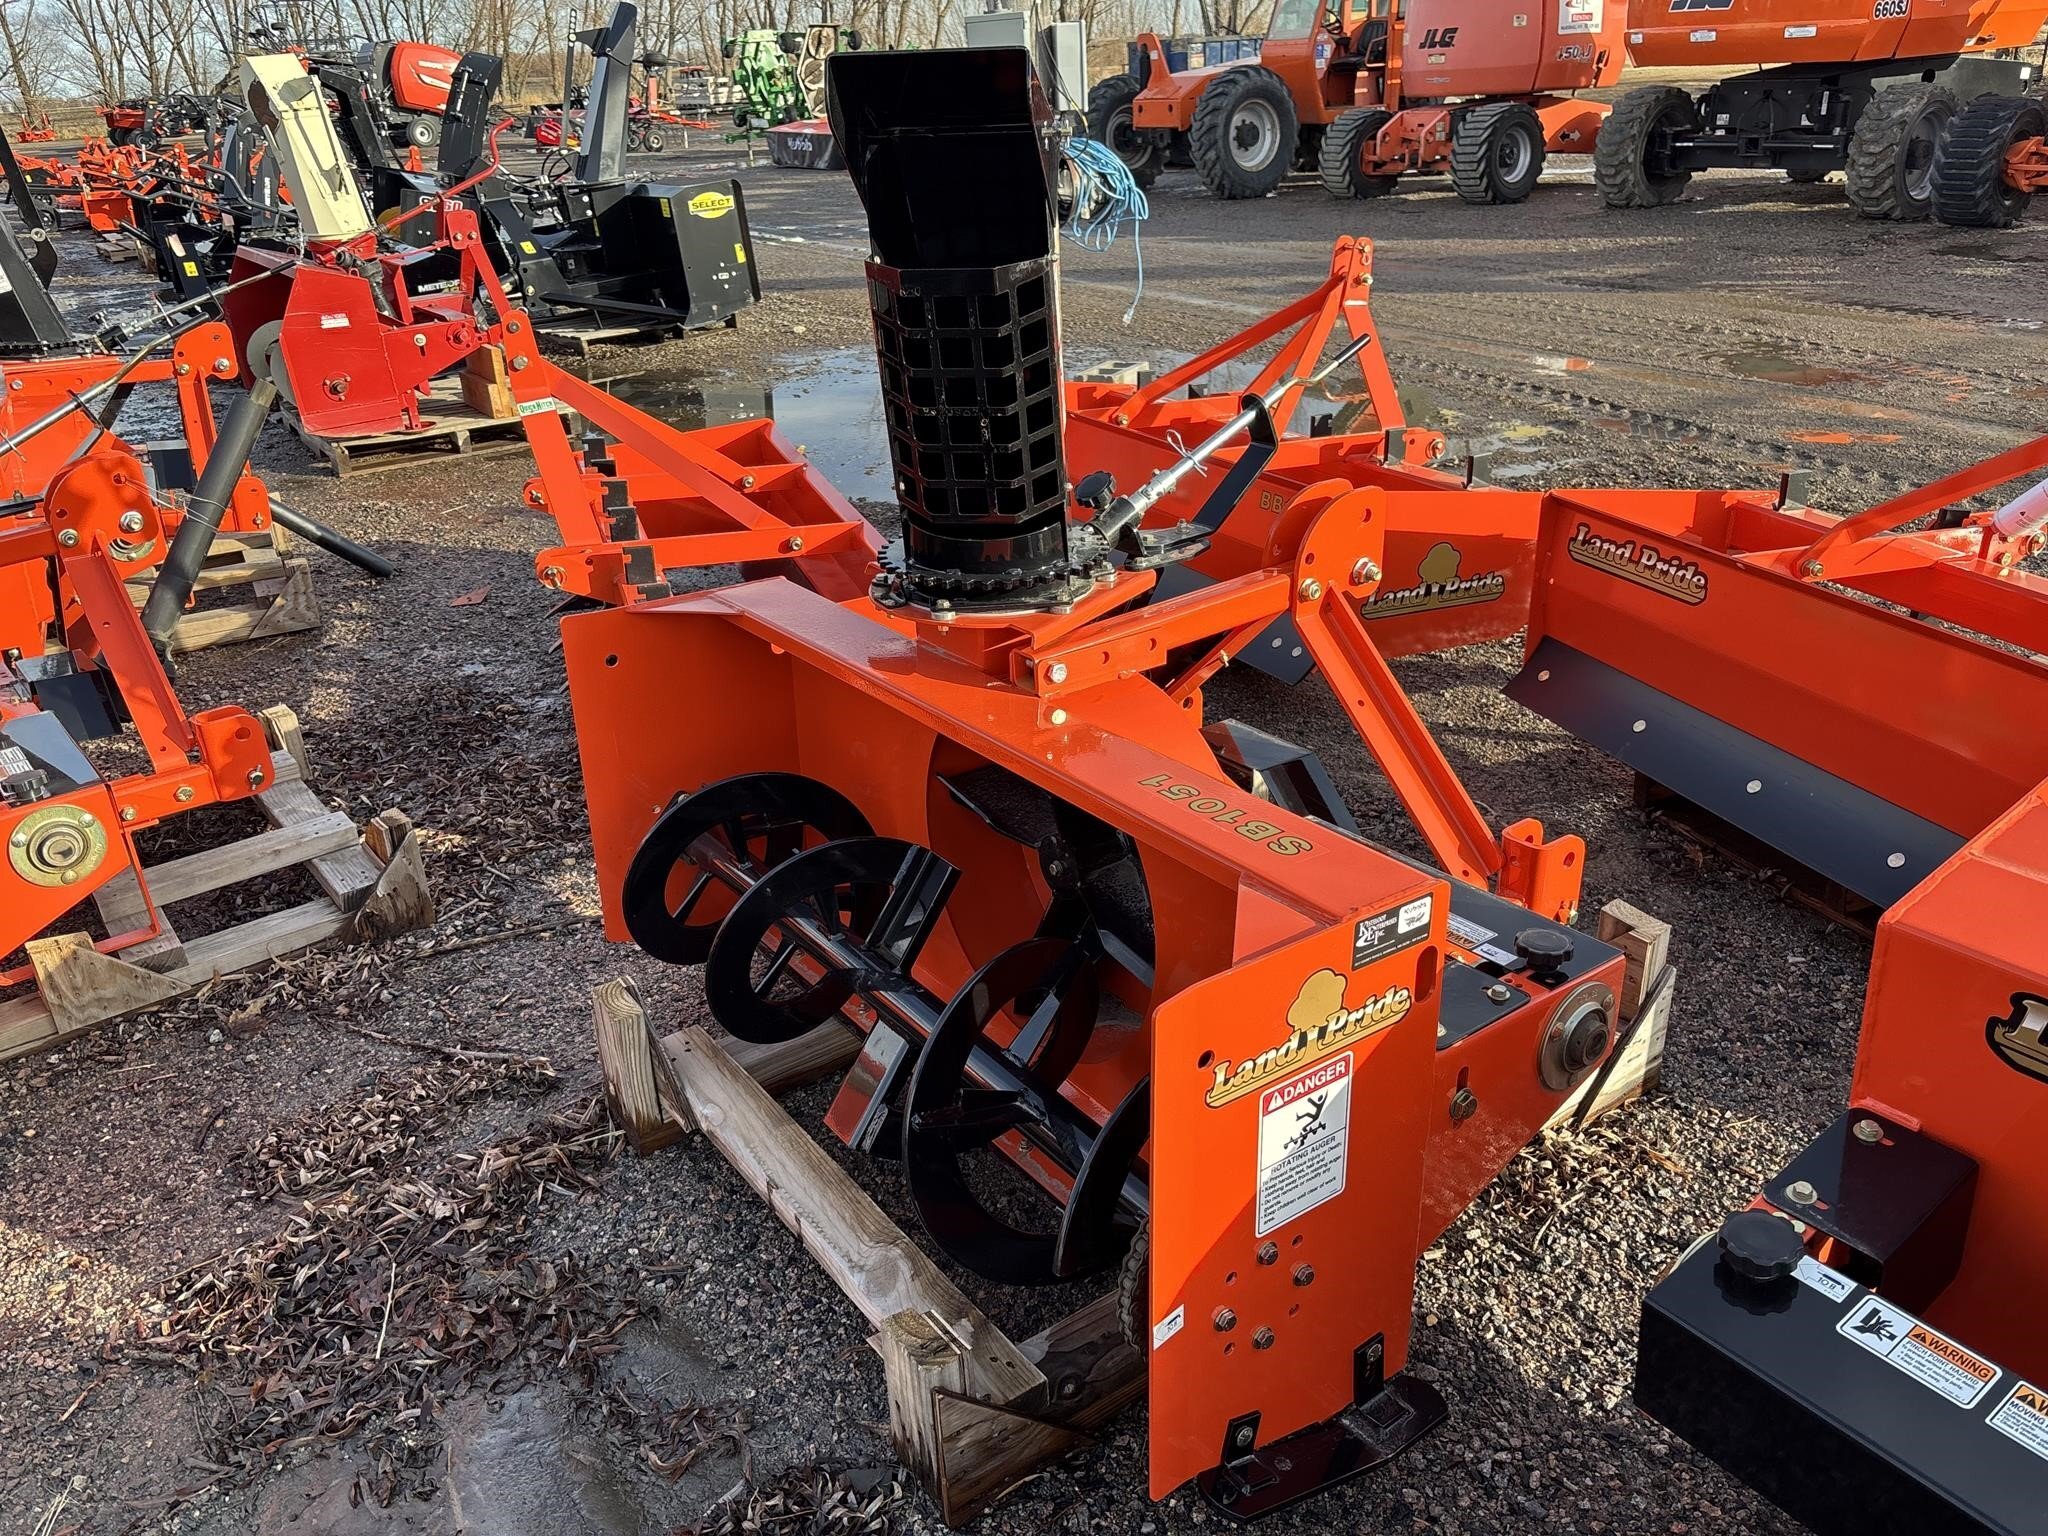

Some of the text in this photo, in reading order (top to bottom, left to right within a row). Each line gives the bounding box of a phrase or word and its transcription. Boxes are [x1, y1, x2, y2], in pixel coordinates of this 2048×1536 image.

[1874, 0, 1909, 18] 660SJ
[1418, 27, 1459, 49] JLG
[691, 198, 731, 210] SELECT
[1261, 491, 1283, 514] BB
[1573, 525, 1706, 596] Land Pride
[1364, 572, 1504, 610] Land Pride
[1138, 773, 1314, 856] SB1051
[1209, 986, 1409, 1098] Land Pride
[1283, 1060, 1346, 1102] DANGER
[1271, 1135, 1336, 1175] ROTATING AUGER
[1906, 1340, 1980, 1386] PINCH POINT HAZARD
[1929, 1337, 1991, 1379] WARNING
[2009, 1401, 2045, 1425] MOVING
